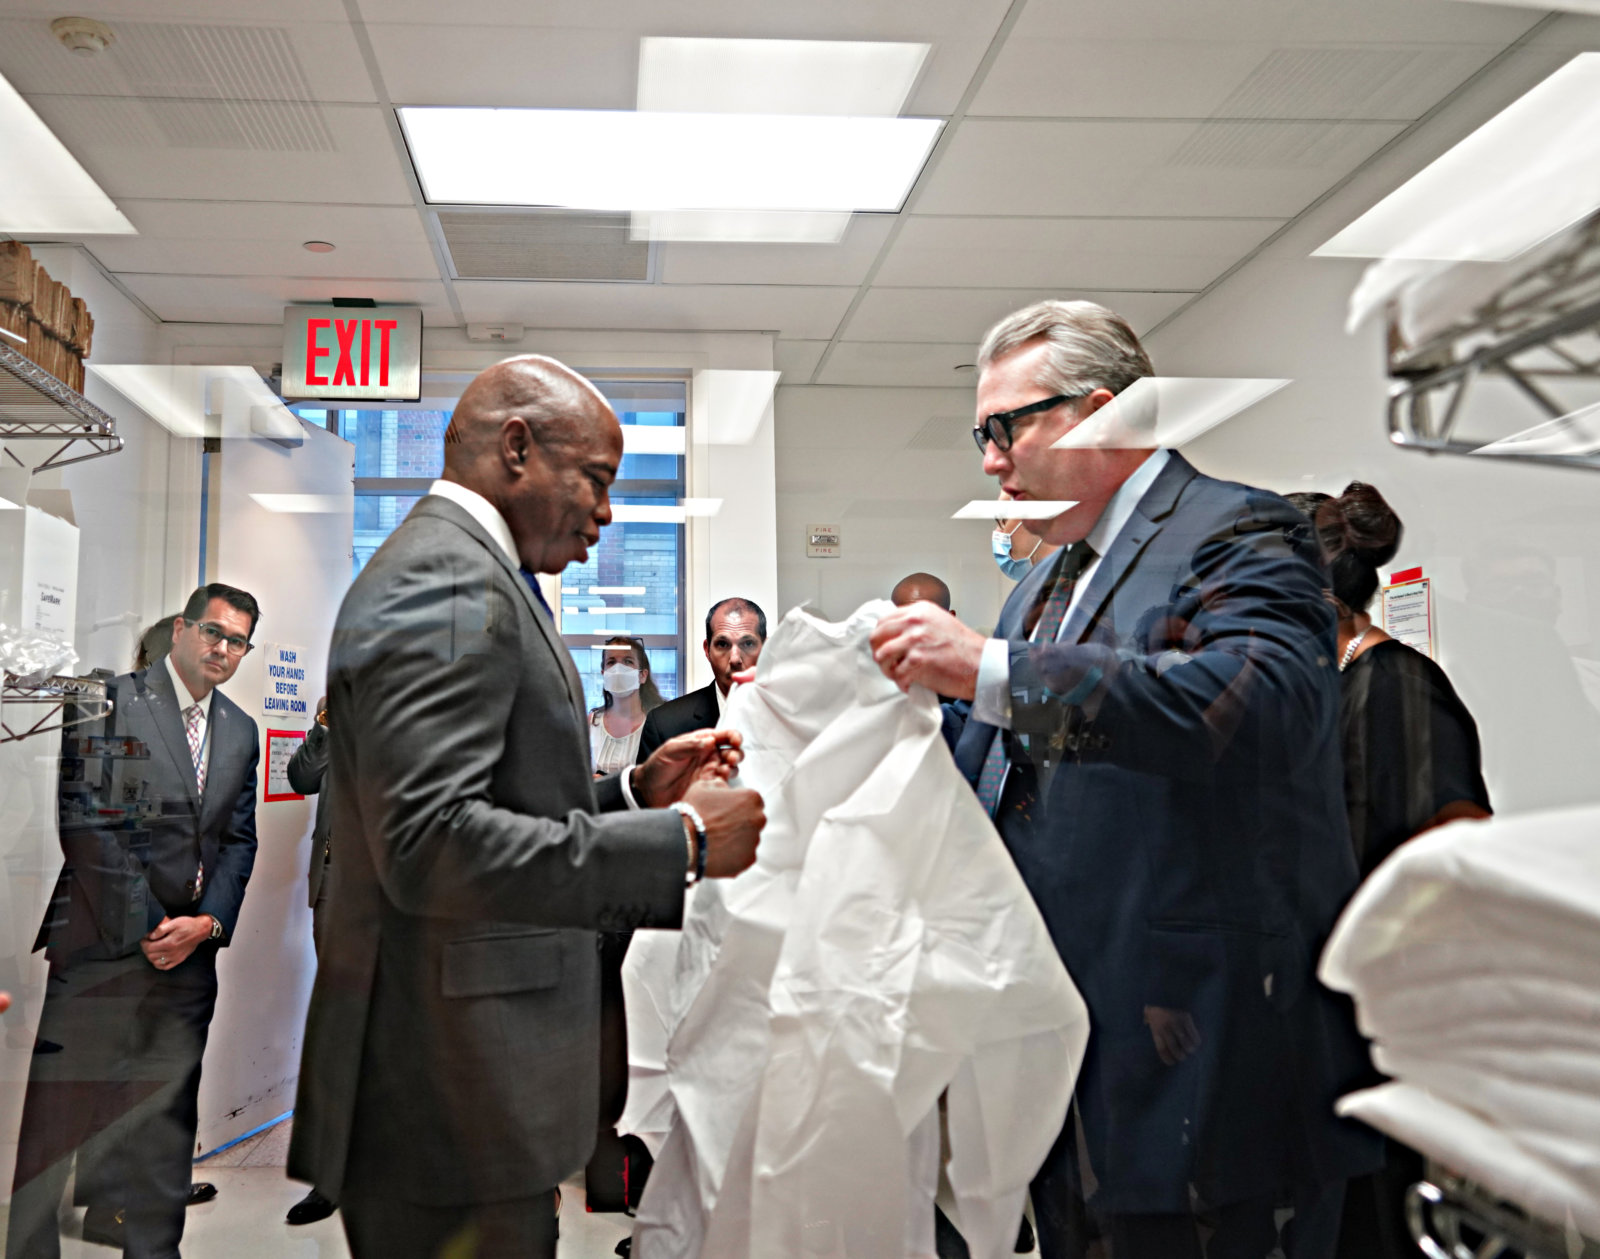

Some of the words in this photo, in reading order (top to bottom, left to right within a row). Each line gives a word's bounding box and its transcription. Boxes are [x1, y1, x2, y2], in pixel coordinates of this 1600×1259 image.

[305, 318, 398, 387] EXIT
[279, 649, 297, 663] WASH
[268, 664, 285, 677] YOUR
[285, 667, 305, 681] HANDS
[275, 681, 298, 696] BEFORE
[264, 697, 289, 711] LEAVING
[290, 699, 307, 713] ROOM
